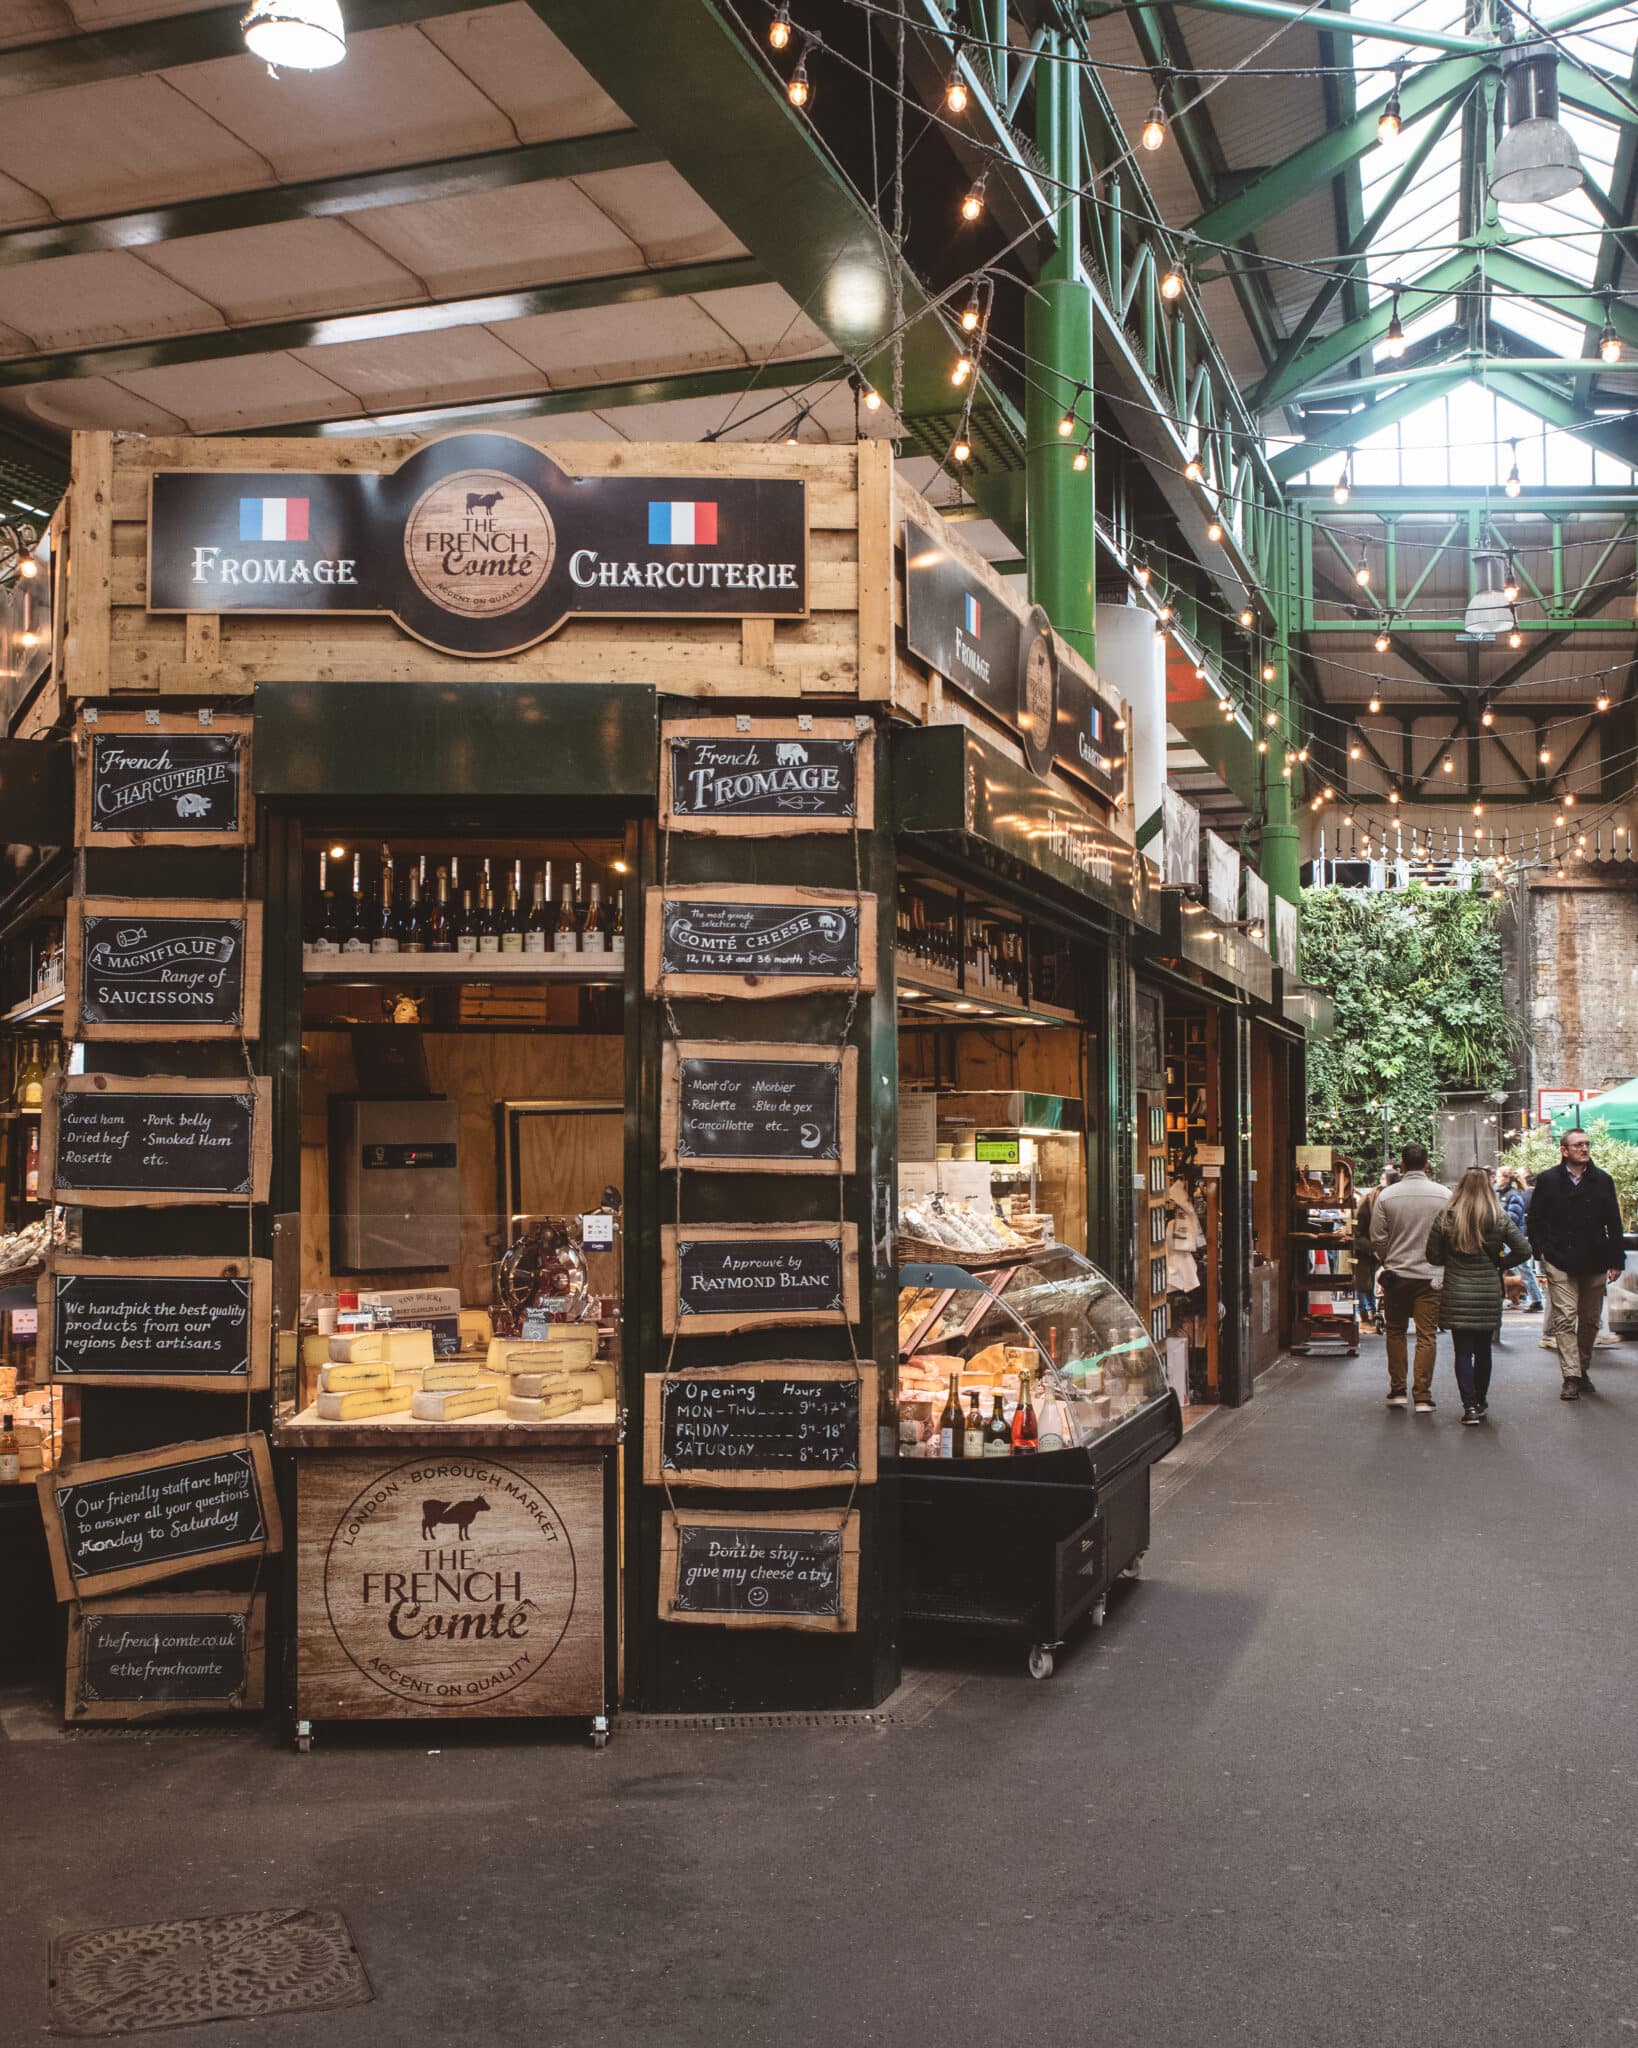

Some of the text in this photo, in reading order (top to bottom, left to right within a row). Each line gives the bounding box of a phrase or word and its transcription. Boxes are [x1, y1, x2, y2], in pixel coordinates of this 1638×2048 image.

[462, 518, 499, 533] THE
[426, 532, 528, 553] FRENCH
[192, 547, 358, 585] FROMAGE
[569, 549, 799, 589] CHARCUTERIE
[436, 582, 524, 605] ACCENT ON QUALITY
[955, 626, 990, 684] FROMAGE
[100, 749, 173, 775] French
[693, 744, 760, 766] French
[98, 765, 226, 813] CHARCUTERIE
[688, 767, 841, 810] FROMAGE
[678, 918, 812, 950] COMTÉ CHEESE
[701, 919, 751, 930] selection of
[92, 940, 217, 969] A MAGNIFIQUE
[718, 954, 733, 964] 24
[735, 954, 754, 964] and
[757, 954, 771, 964] 36
[160, 967, 227, 989] Range of
[98, 987, 215, 1005] SAUCISSONS
[754, 1080, 796, 1092] Morbier
[690, 1099, 737, 1112] Raclette
[755, 1100, 813, 1116] Bleu de gex
[67, 1113, 125, 1125] Cured ham
[147, 1113, 212, 1133] Pork belly
[66, 1131, 131, 1150] Dried beef
[148, 1132, 232, 1147] Smoked Ham
[65, 1151, 112, 1164] Rosette
[143, 1154, 169, 1166] etc.
[788, 1255, 802, 1271] by
[690, 1272, 830, 1292] RAYMOND BLANC
[64, 1301, 247, 1326] We handpick the best quality
[64, 1318, 211, 1334] products from our
[64, 1335, 222, 1354] regions best artisans
[685, 1382, 822, 1402] Opening Hours
[676, 1423, 730, 1438] FRIDAY
[675, 1441, 755, 1457] SATURDAY
[75, 1468, 249, 1518] Our friendly staff are happy
[77, 1488, 250, 1534] to answer all your questions
[343, 1464, 559, 1547] LONDON BOROUGH MARKET
[77, 1509, 240, 1557] Monday to Saturday
[418, 1549, 475, 1570] THE
[748, 1543, 766, 1559] be
[685, 1563, 834, 1588] give my cheese a try
[363, 1571, 521, 1605] FRENCH
[367, 1651, 532, 1697] ACCENT ON QUALITY
